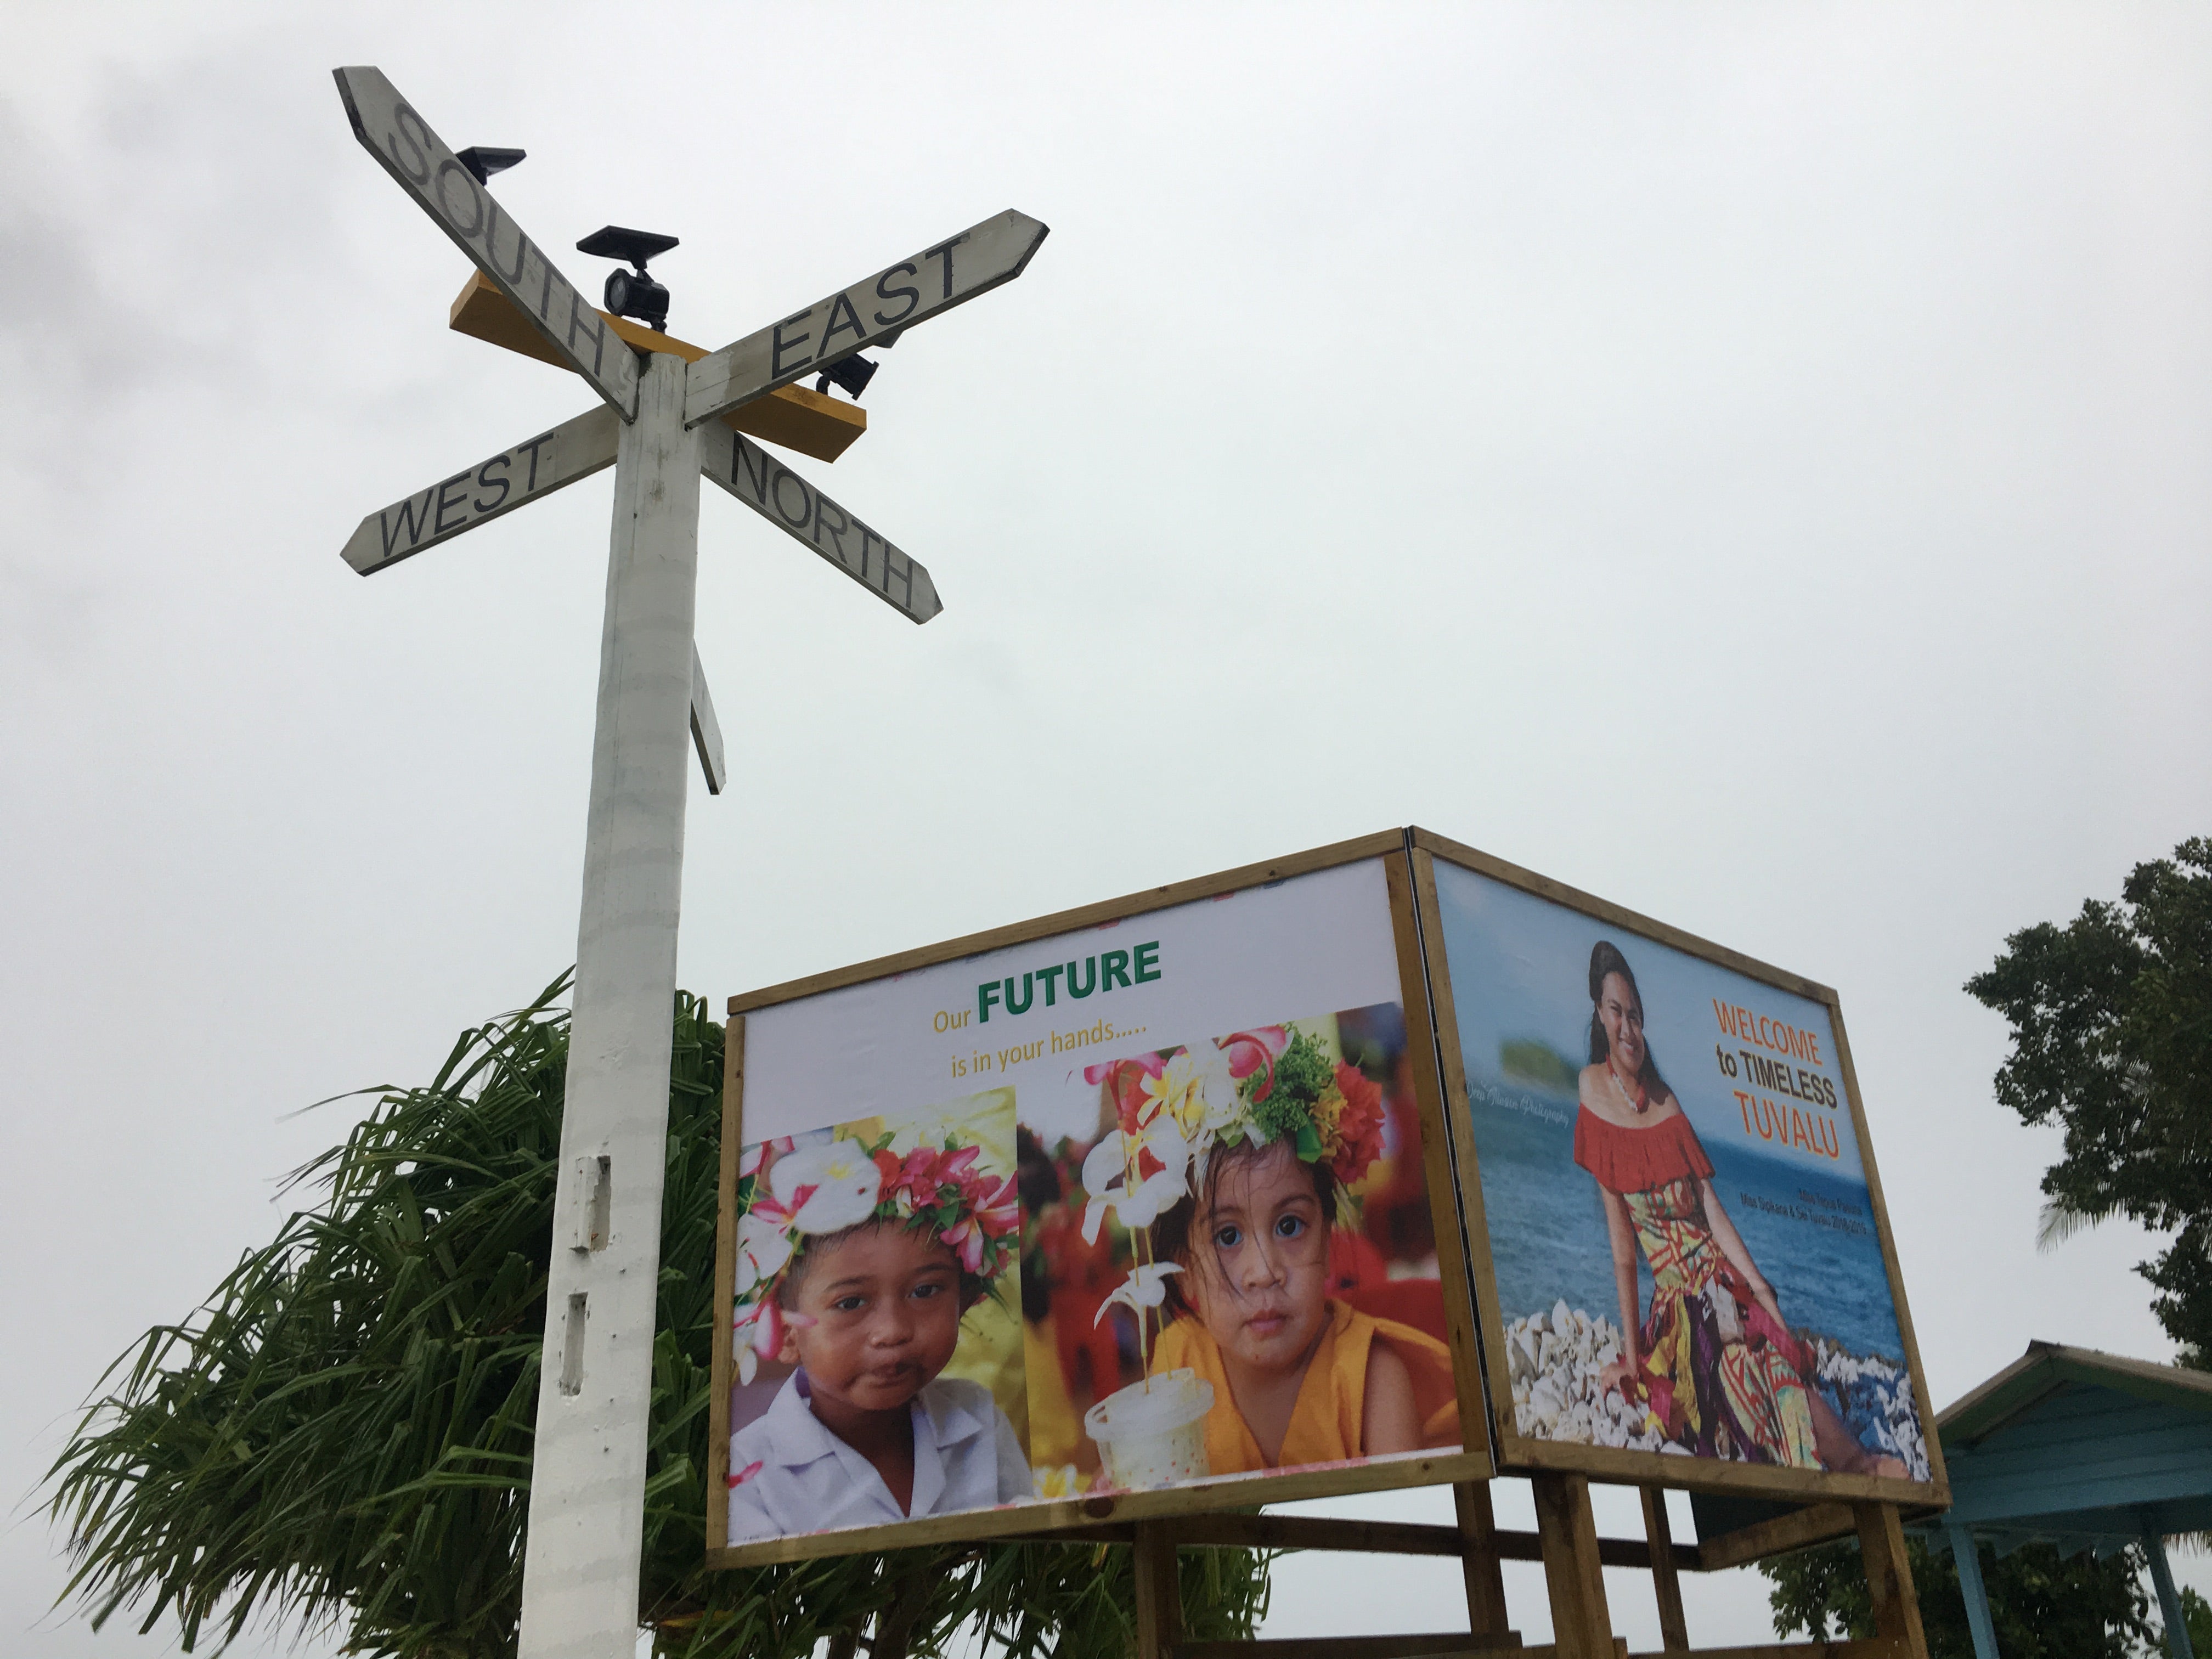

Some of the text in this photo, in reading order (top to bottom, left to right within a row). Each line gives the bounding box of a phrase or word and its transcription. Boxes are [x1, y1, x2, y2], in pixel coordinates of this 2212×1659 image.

[387, 101, 605, 378] SOUTH
[771, 232, 970, 380] EAST
[380, 432, 554, 557] WEST
[731, 431, 913, 609] NORTH
[933, 940, 1161, 1033] Our FUTURE
[1712, 997, 1823, 1066] WELCOME
[951, 1054, 967, 1078] is
[973, 1049, 991, 1073] in
[997, 1040, 1045, 1073] your
[1716, 1043, 1838, 1110] to TIMELESS
[1733, 1089, 1839, 1161] TUVALU
